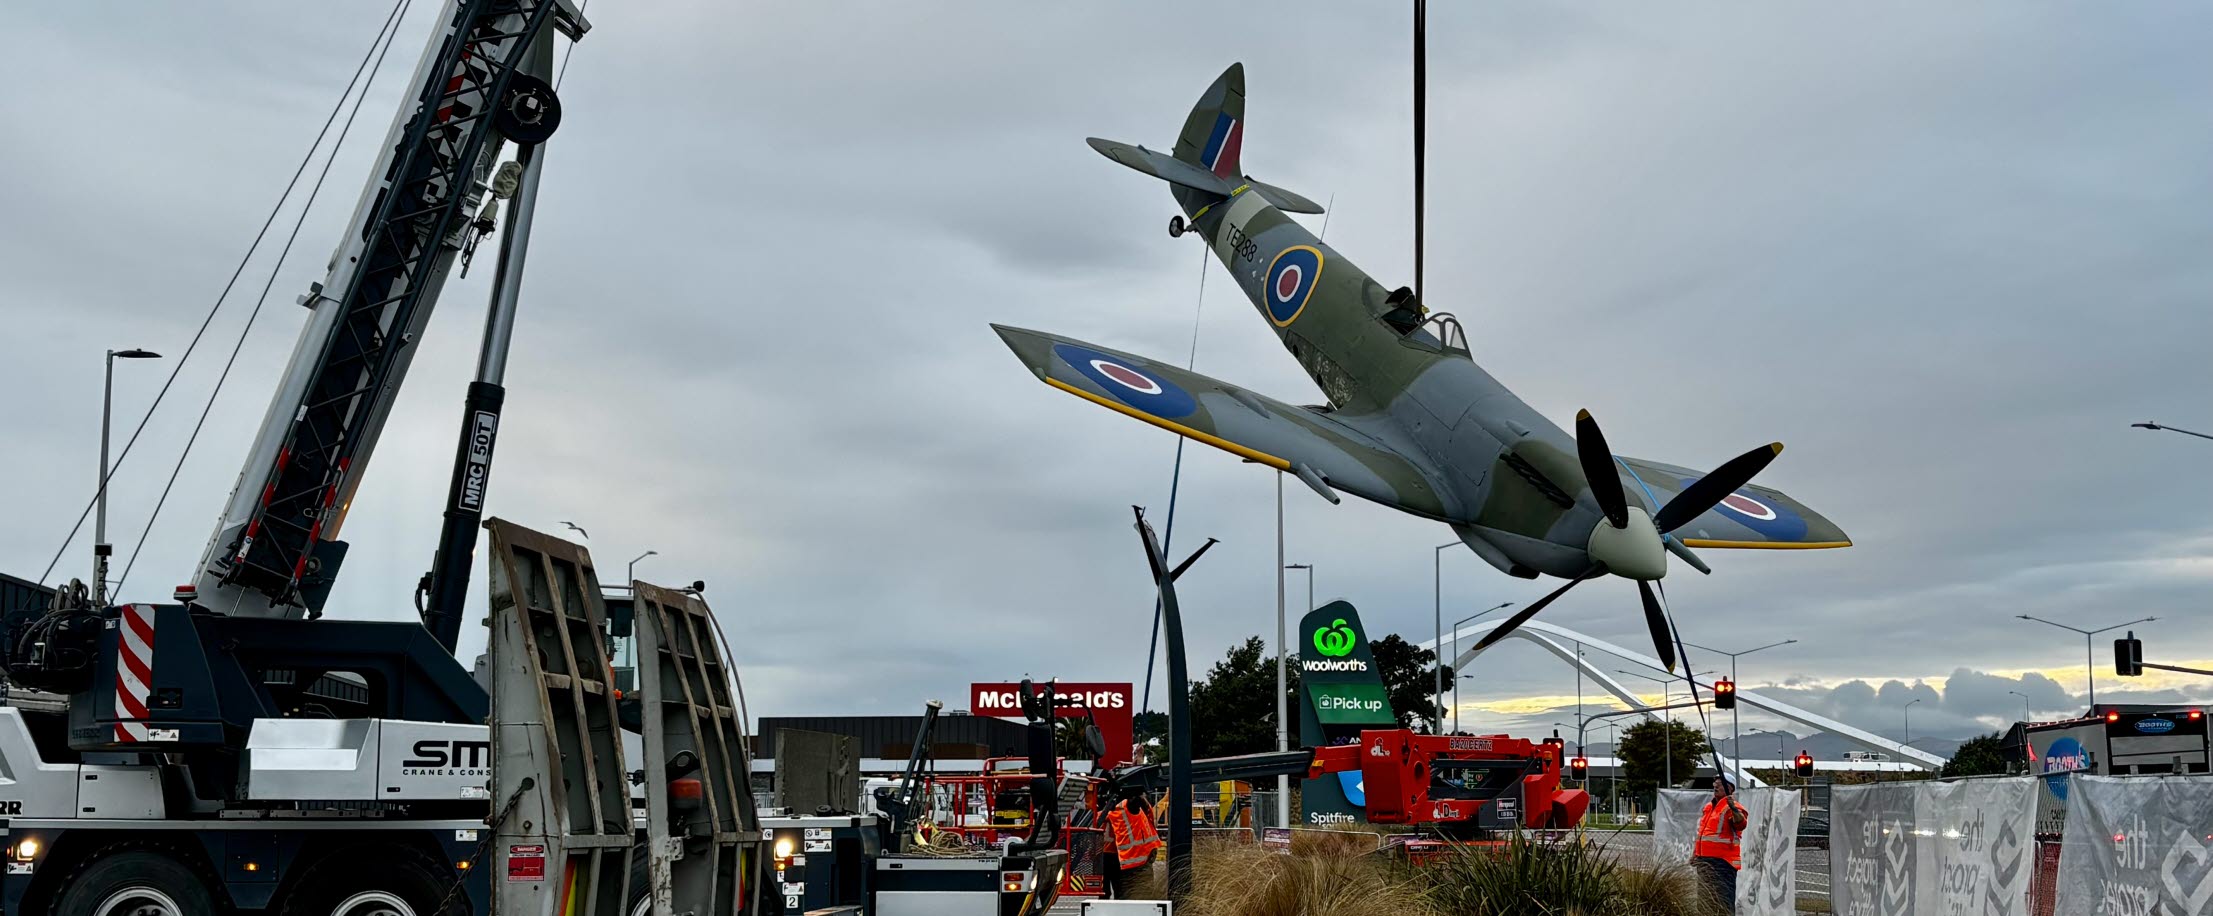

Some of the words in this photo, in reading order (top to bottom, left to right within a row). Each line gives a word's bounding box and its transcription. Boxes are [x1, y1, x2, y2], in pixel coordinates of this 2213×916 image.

[1225, 223, 1258, 263] TE288
[473, 422, 491, 457] 50T
[464, 465, 484, 506] MRC
[1333, 697, 1362, 709] Pick
[1364, 699, 1383, 713] up
[1310, 811, 1355, 826] Spitfire
[788, 896, 796, 907] 2
